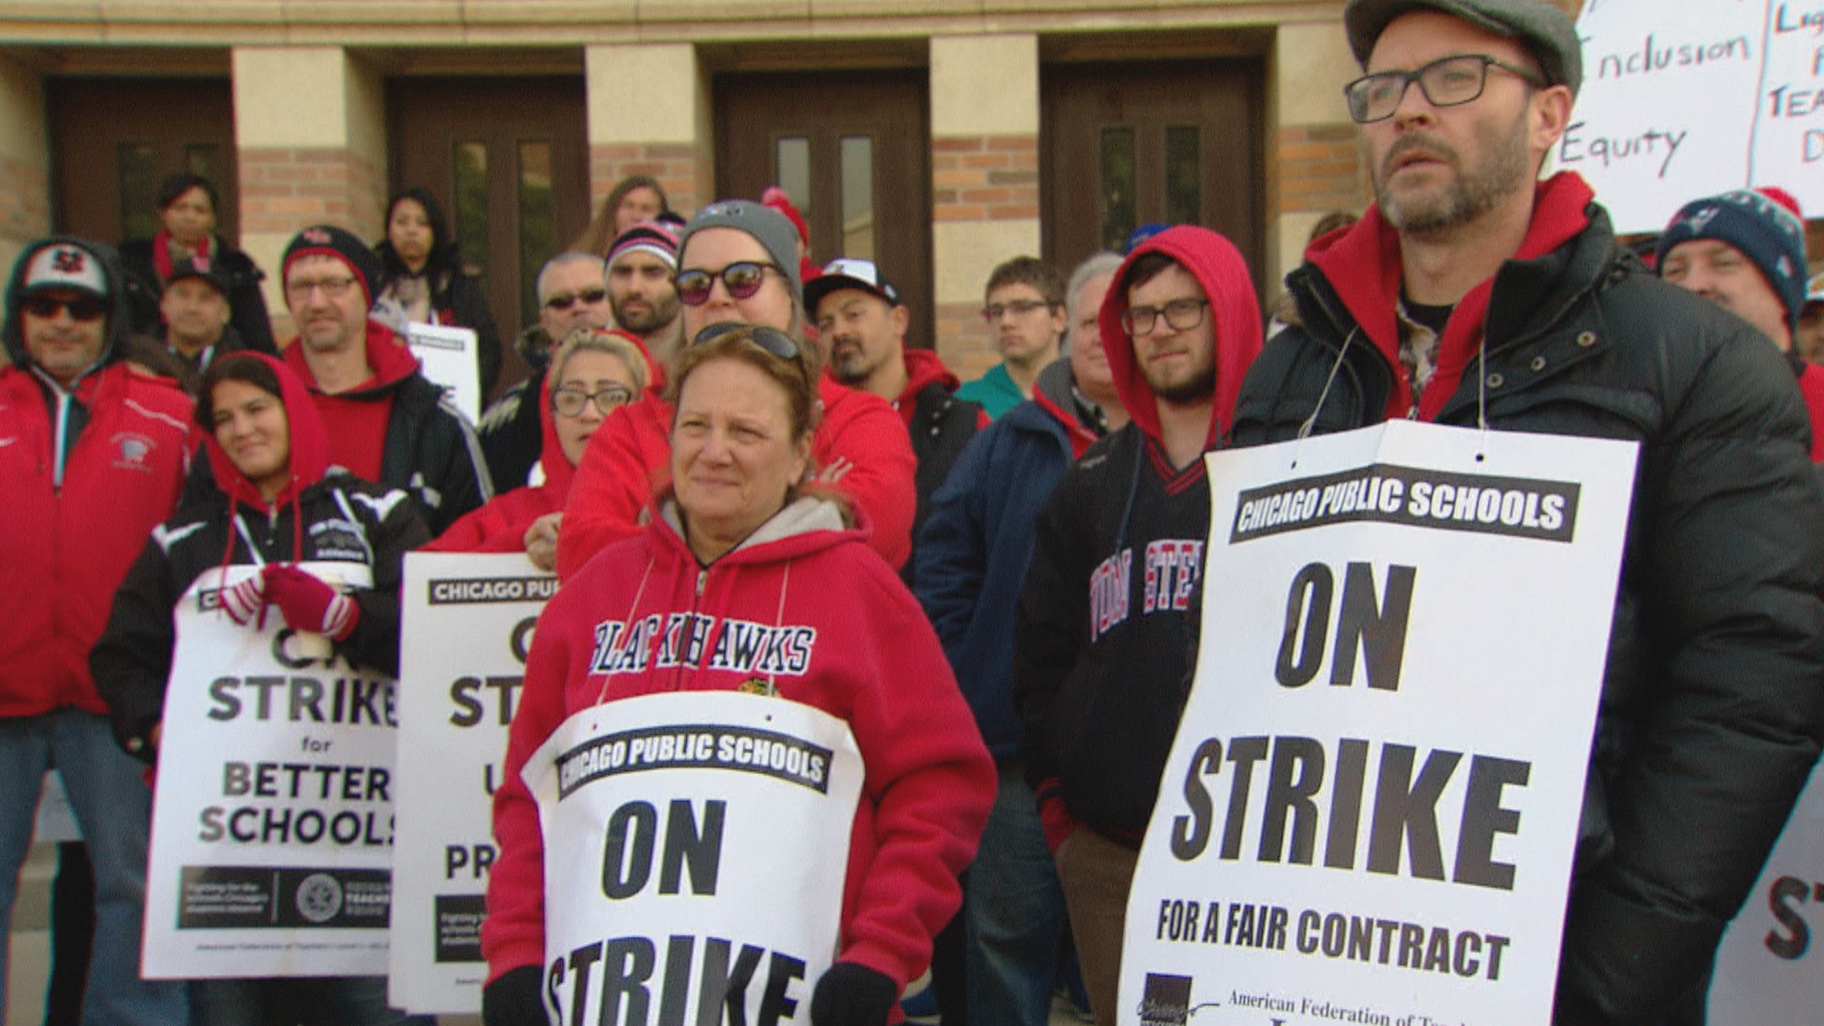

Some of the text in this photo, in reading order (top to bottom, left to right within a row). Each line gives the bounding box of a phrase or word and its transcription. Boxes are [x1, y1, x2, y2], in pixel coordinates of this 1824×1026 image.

[1581, 33, 1751, 79] nclusion
[1559, 121, 1688, 179] Equity
[1237, 477, 1566, 533] CHICAGO PUBLIC SCHOOLS
[433, 581, 523, 600] CHICAGO
[1275, 561, 1418, 691] ON
[302, 736, 334, 753] for
[560, 733, 826, 792] CHICAGO PUBLIC SCHOOLS
[222, 761, 391, 801] BETTER
[1171, 735, 1533, 891] STRIKE
[601, 798, 728, 901] ON
[1156, 898, 1510, 981] FOR A FAIR CONTRACT
[1763, 875, 1824, 961] S
[549, 934, 806, 1026] STRIKE
[1228, 988, 1295, 1014] American
[1300, 997, 1391, 1026] Federation
